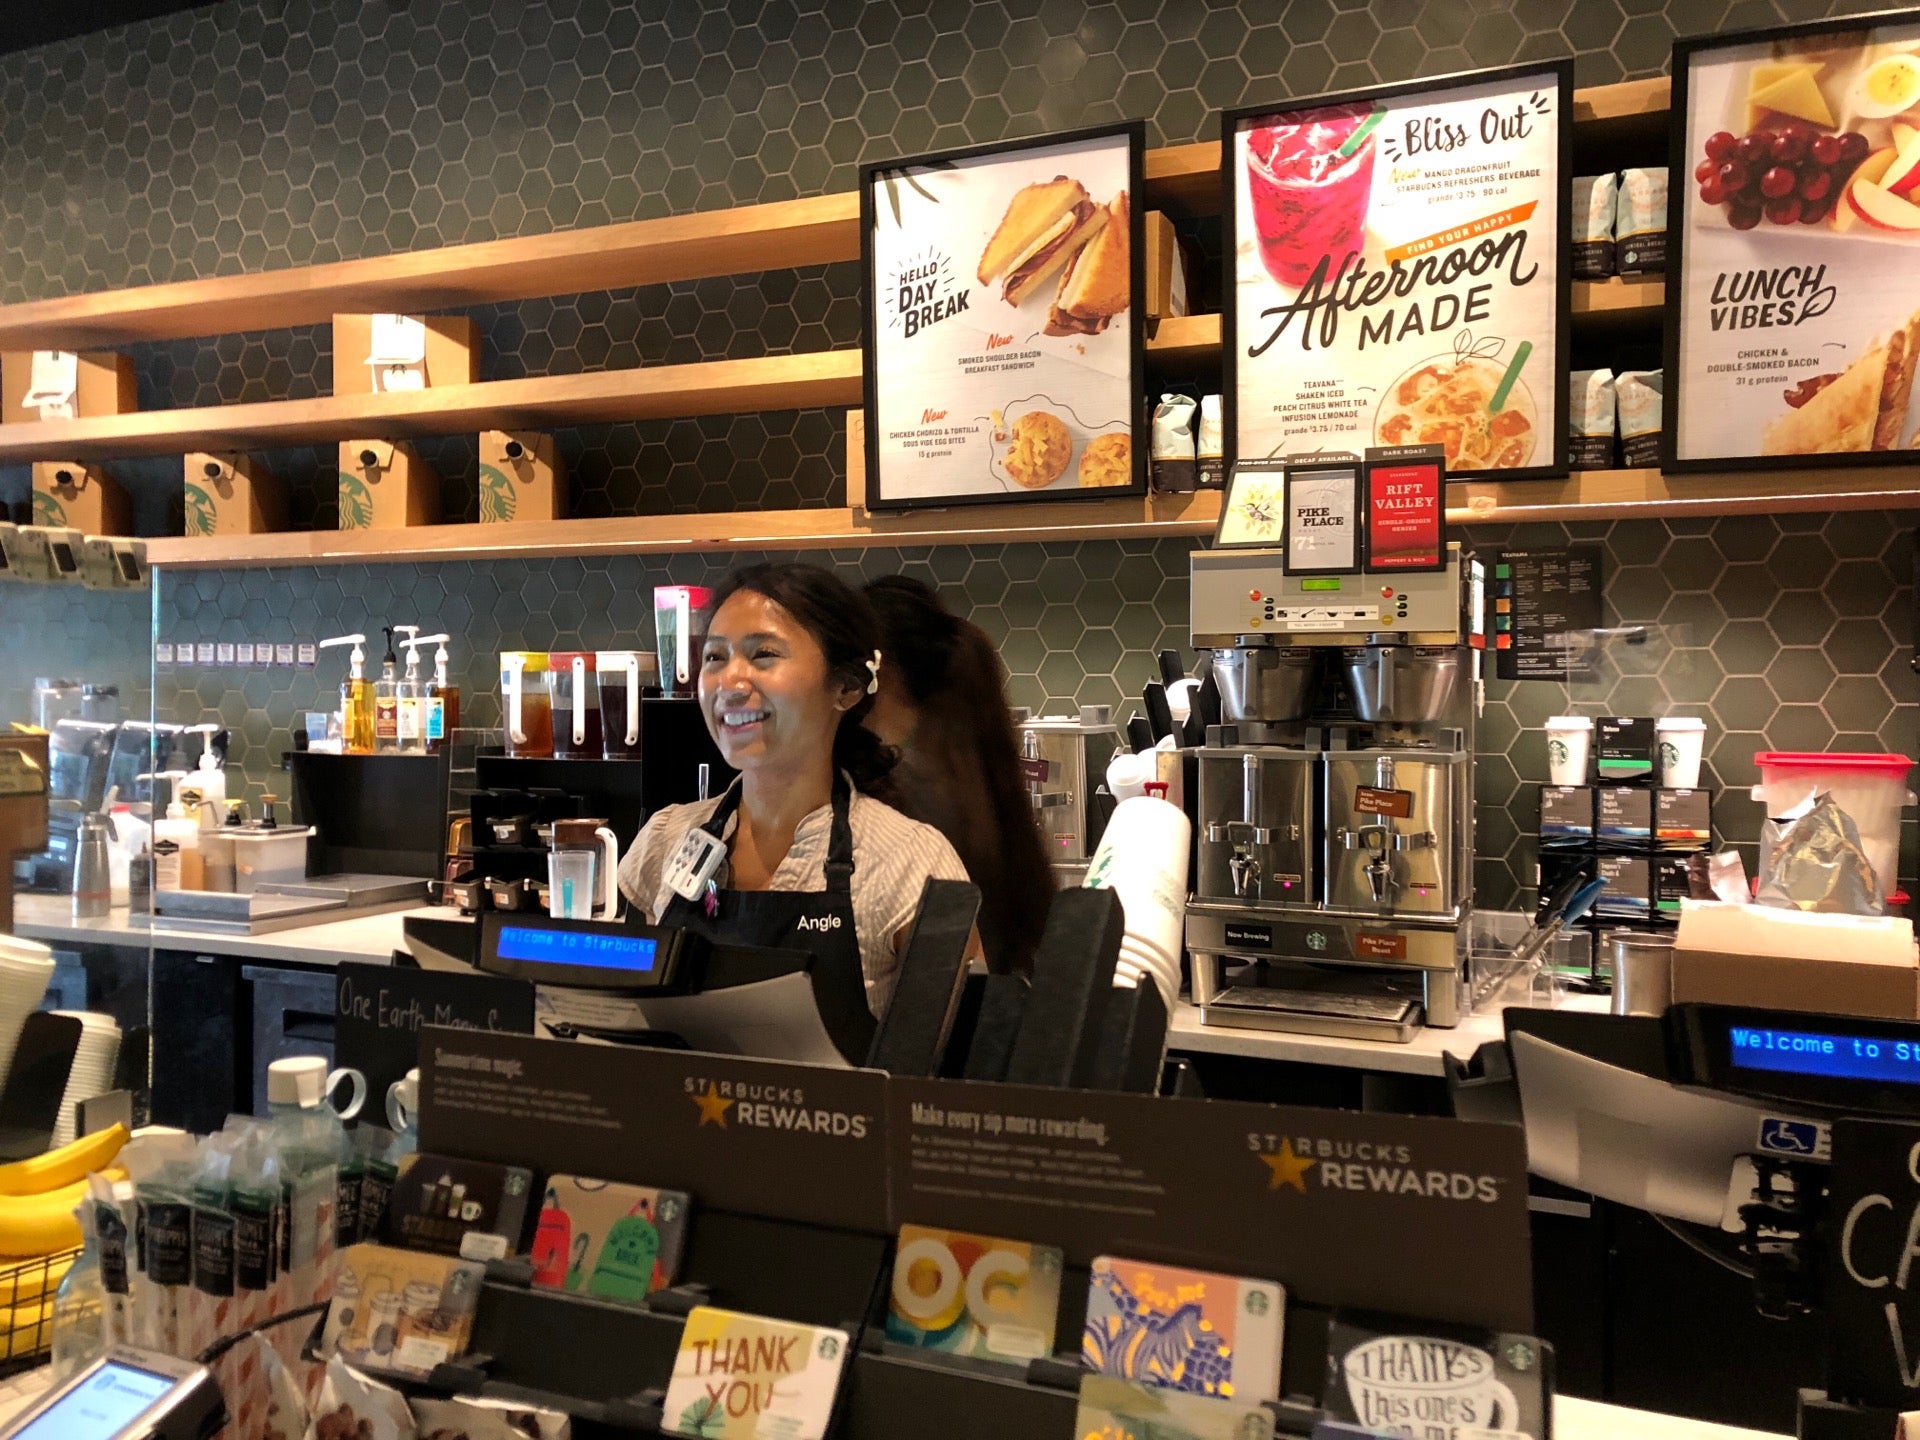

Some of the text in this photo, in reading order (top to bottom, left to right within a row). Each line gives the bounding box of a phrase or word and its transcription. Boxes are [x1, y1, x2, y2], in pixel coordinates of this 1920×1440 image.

[1406, 104, 1532, 156] Bliss Out
[1424, 170, 1453, 178] MANGO
[1455, 161, 1510, 176] DRAGONFRUIT
[1397, 168, 1540, 194] STARBUCKS REFRESHERS BEVERAGE
[1495, 186, 1508, 195] cal
[1407, 214, 1512, 256] FIND YOUR HAPPY
[899, 262, 937, 286] HELLO
[1248, 230, 1538, 358] Afternoon
[1710, 264, 1826, 305] LUNCH
[898, 279, 938, 314] DAY
[904, 289, 970, 338] BREAK
[1358, 284, 1492, 350] MADE
[1710, 300, 1796, 331] VIBES
[986, 334, 1014, 350] New
[958, 350, 1041, 365] SMOKED SHOULDER BACON
[1737, 348, 1788, 360] CHICKEN &
[964, 362, 1034, 374] BREAKFAST SANDWICH
[1707, 358, 1819, 373] DOUBLE-SMOKED BACON
[1736, 376, 1746, 385] 31
[1756, 374, 1788, 386] protein
[1296, 390, 1344, 400] SHAKEN ICED
[921, 408, 948, 424] New
[1273, 403, 1297, 412] PEACH
[1299, 402, 1326, 411] CITRUS
[1328, 400, 1351, 408] WHITE
[1282, 410, 1358, 422] INFUSION LEMONADE
[890, 431, 915, 439] CHICKEN
[916, 429, 942, 437] CHORIZO
[951, 426, 979, 434] TORTILLA
[1284, 427, 1307, 436] grande
[1386, 484, 1423, 495] RIFT
[1297, 508, 1330, 517] PIKE
[1375, 497, 1434, 509] VALLEY
[1303, 517, 1344, 527] PLACE
[502, 929, 654, 954] Welcome to Starbucks
[1243, 932, 1270, 942] Brewing
[339, 977, 371, 1020] One
[378, 989, 425, 1032] Earth
[1732, 1029, 1835, 1054] Welcome
[1853, 1039, 1880, 1058] to
[737, 1102, 866, 1139] REWARDS
[1320, 1162, 1499, 1203] REWARDS
[692, 1335, 798, 1375] THANK
[1356, 1342, 1483, 1382] THANKS
[705, 1380, 774, 1418] YOU
[1362, 1388, 1410, 1426] this
